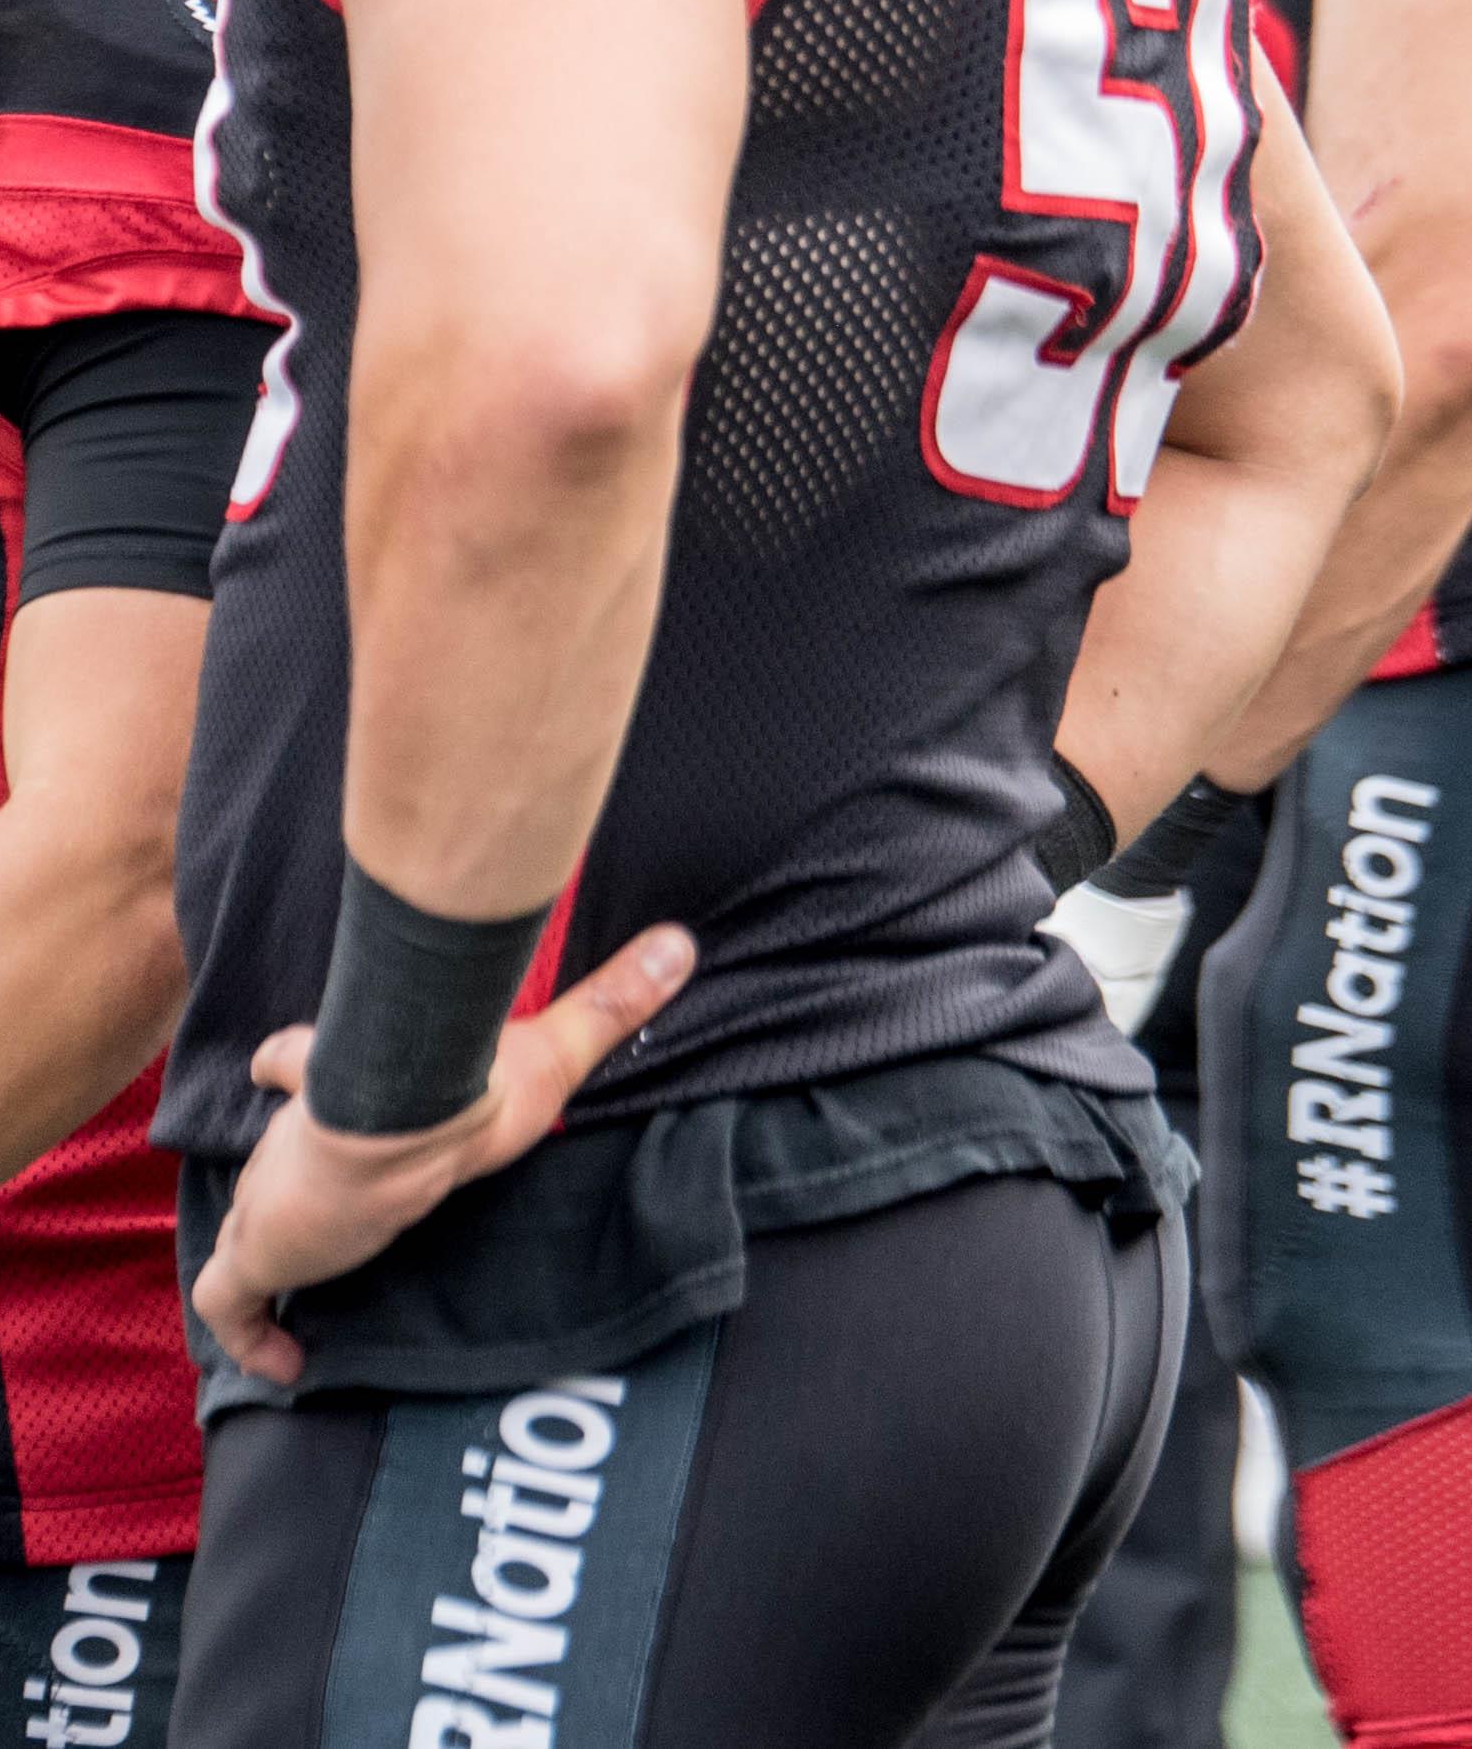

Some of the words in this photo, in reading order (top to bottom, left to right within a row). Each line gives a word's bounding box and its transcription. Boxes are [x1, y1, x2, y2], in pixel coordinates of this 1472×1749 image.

[1287, 773, 1440, 1220] #RNation
[22, 1560, 158, 1749] tion
[407, 1375, 627, 1749] RNatio
